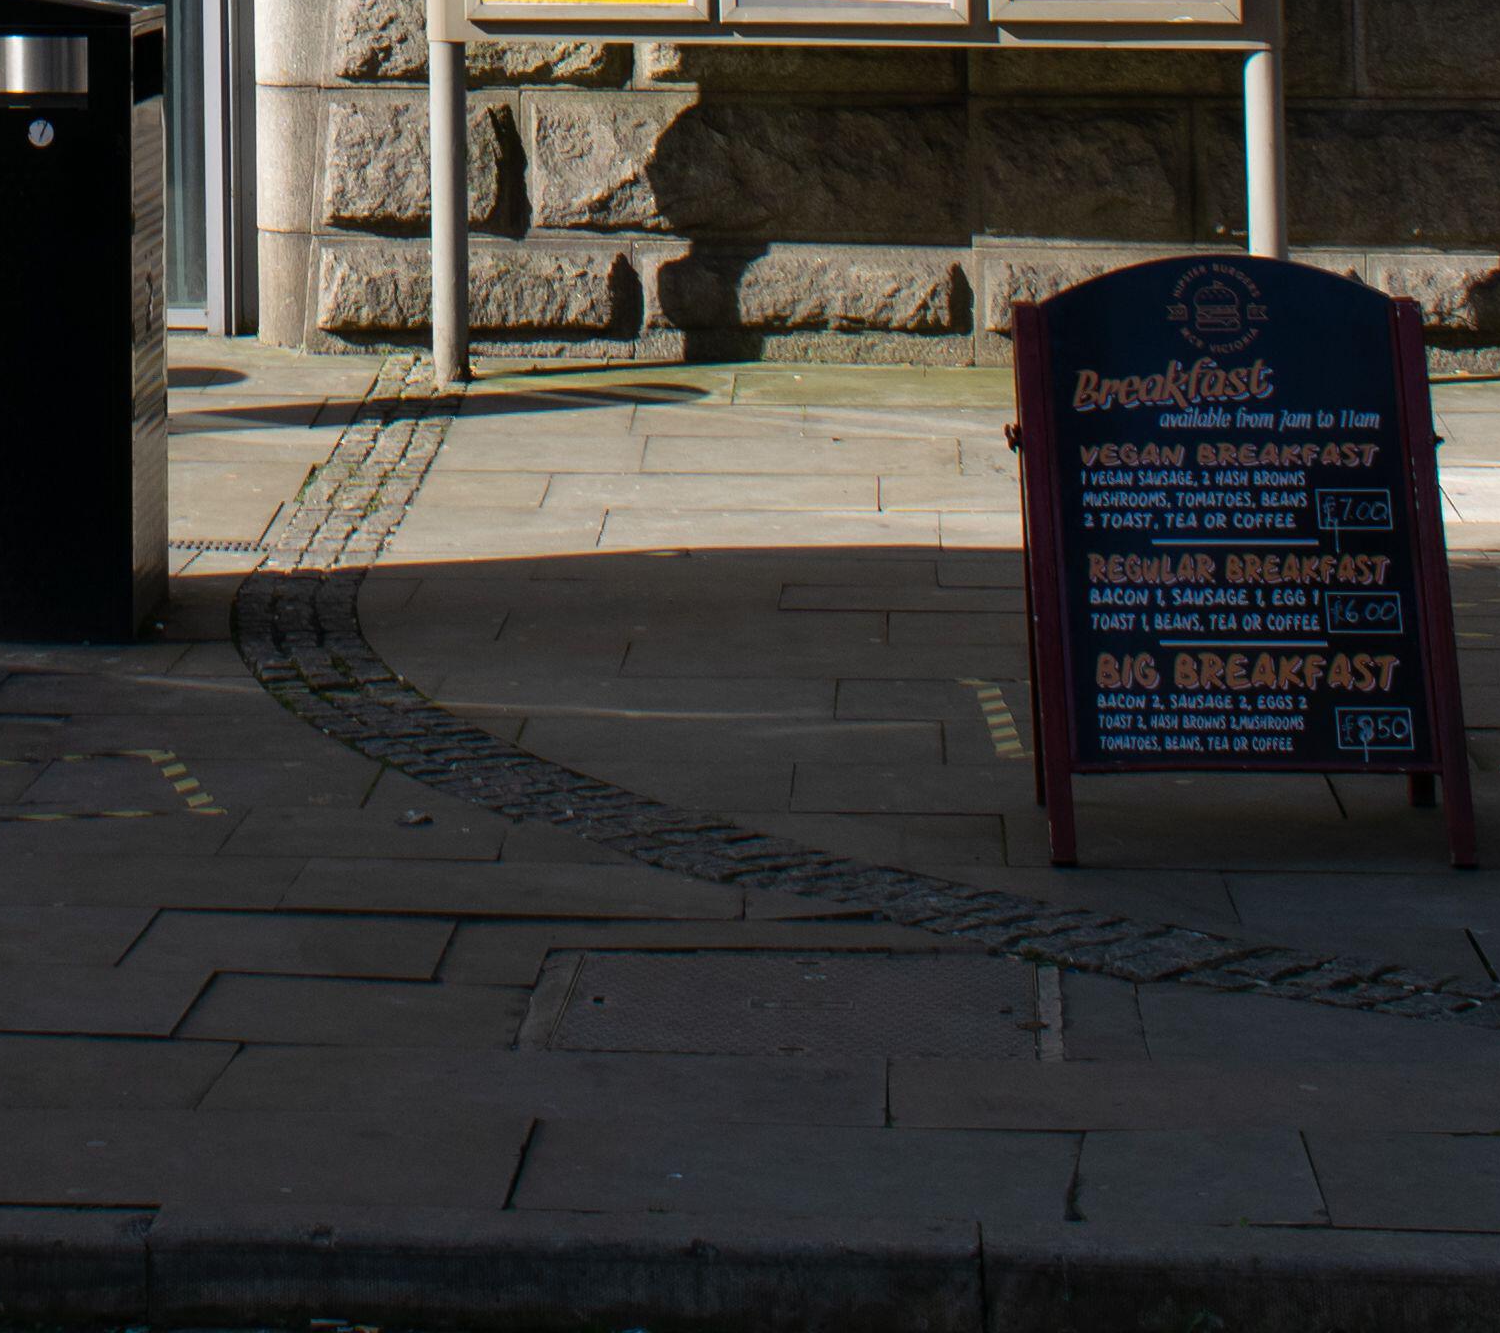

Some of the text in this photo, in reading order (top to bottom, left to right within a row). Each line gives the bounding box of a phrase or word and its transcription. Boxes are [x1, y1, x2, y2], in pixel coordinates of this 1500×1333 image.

[1072, 356, 1275, 412] Breakfast
[1159, 408, 1381, 432] available from 7am to 11am
[1079, 442, 1381, 468] VEGAN BREAKFAST
[1089, 469, 1133, 486] VEGAN
[1215, 469, 1249, 486] HASH
[1252, 469, 1306, 486] BROWNS
[1176, 491, 1256, 509] TOMATOES,
[1260, 491, 1309, 509] BEANS
[1164, 513, 1197, 530] TEA
[1204, 513, 1227, 530] OR
[1232, 513, 1297, 530] COFFEE
[1087, 552, 1392, 584] REGULAR BREAKFAST
[1089, 588, 1150, 607] BACON
[1171, 588, 1250, 607] SAUSAGE
[1271, 588, 1308, 607] EGG
[1090, 613, 1137, 631] TOAST
[1208, 613, 1236, 631] TEA
[1240, 613, 1262, 631] OR
[1266, 613, 1321, 631] COFFEE
[1095, 651, 1400, 690] BIG BREAKFAST
[1097, 694, 1147, 710] BACON
[1169, 694, 1235, 710] SAUSAGE
[1256, 694, 1294, 710] EGGS
[1207, 735, 1229, 751] TEA
[1232, 735, 1249, 751] OR
[1250, 735, 1294, 751] COFFEE
